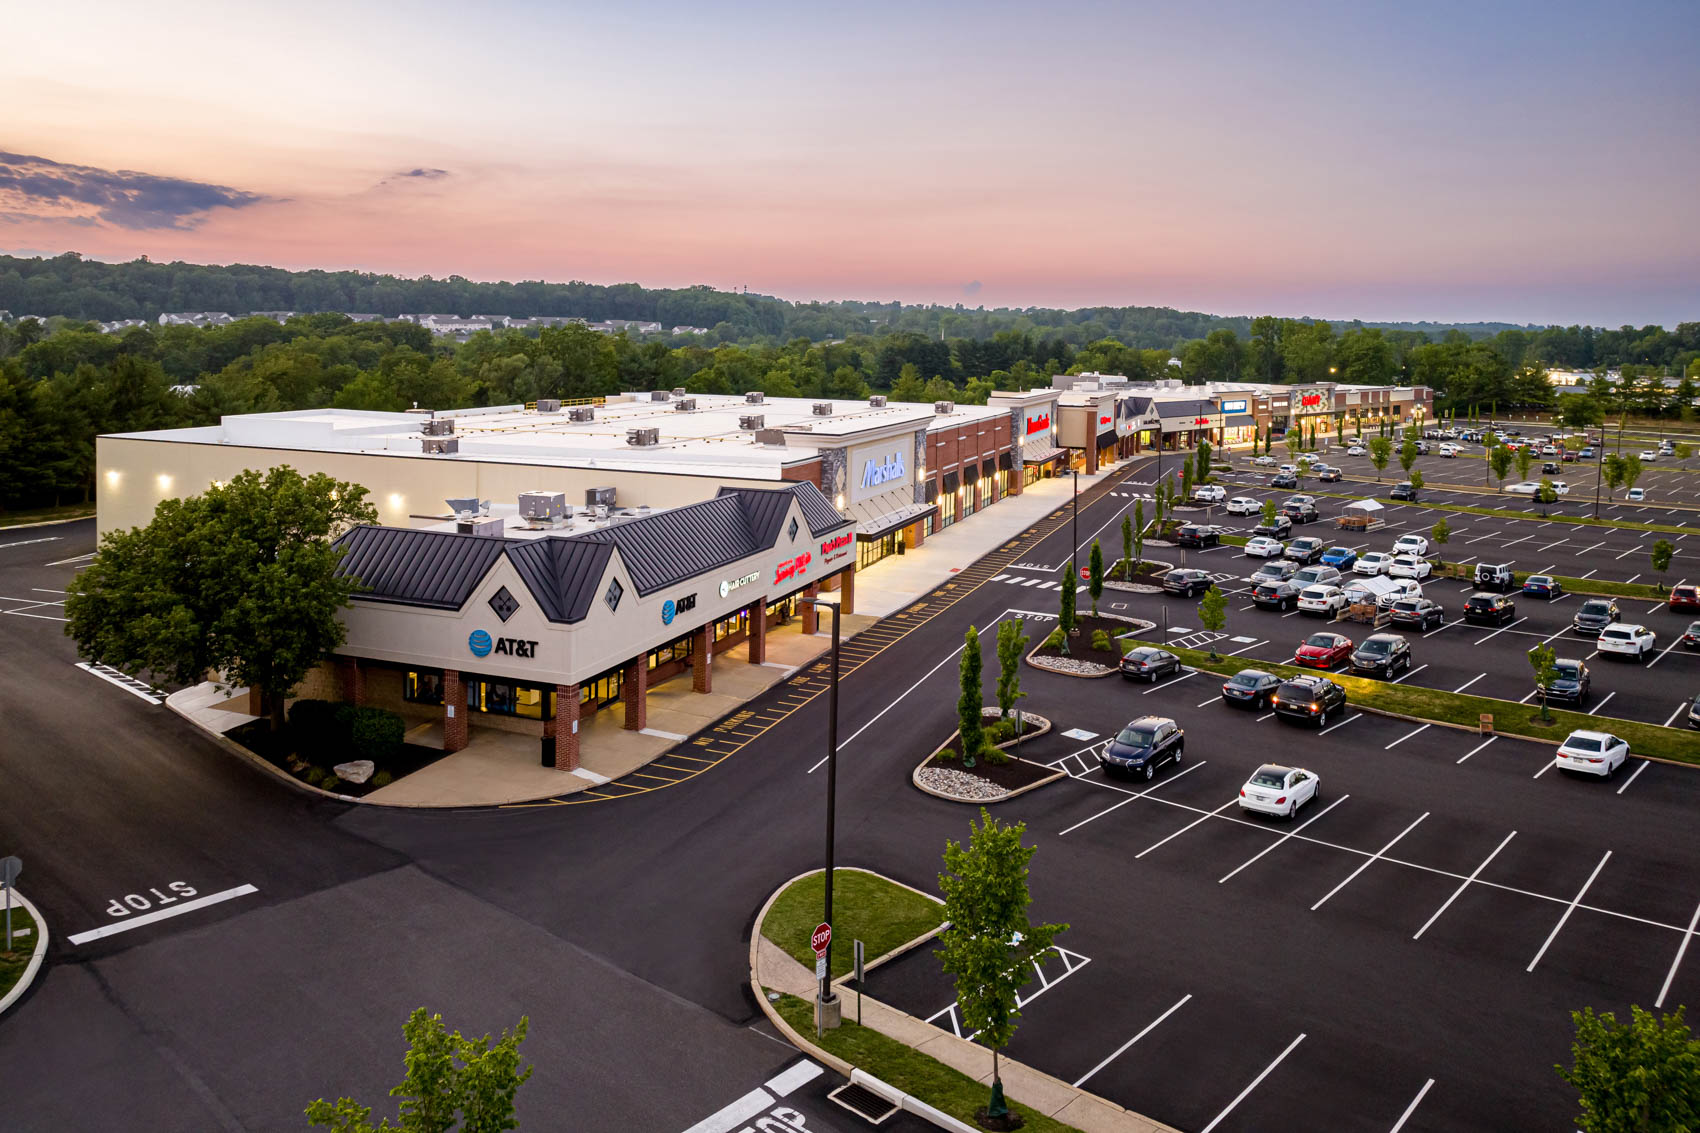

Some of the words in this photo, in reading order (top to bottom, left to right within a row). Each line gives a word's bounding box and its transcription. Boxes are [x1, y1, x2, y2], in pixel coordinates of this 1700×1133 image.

[675, 592, 698, 616] AT&T
[1014, 613, 1054, 622] STOP
[494, 637, 539, 658] AT&T
[713, 710, 756, 733] PARKING
[106, 881, 198, 917] STOP
[813, 929, 830, 946] STOP
